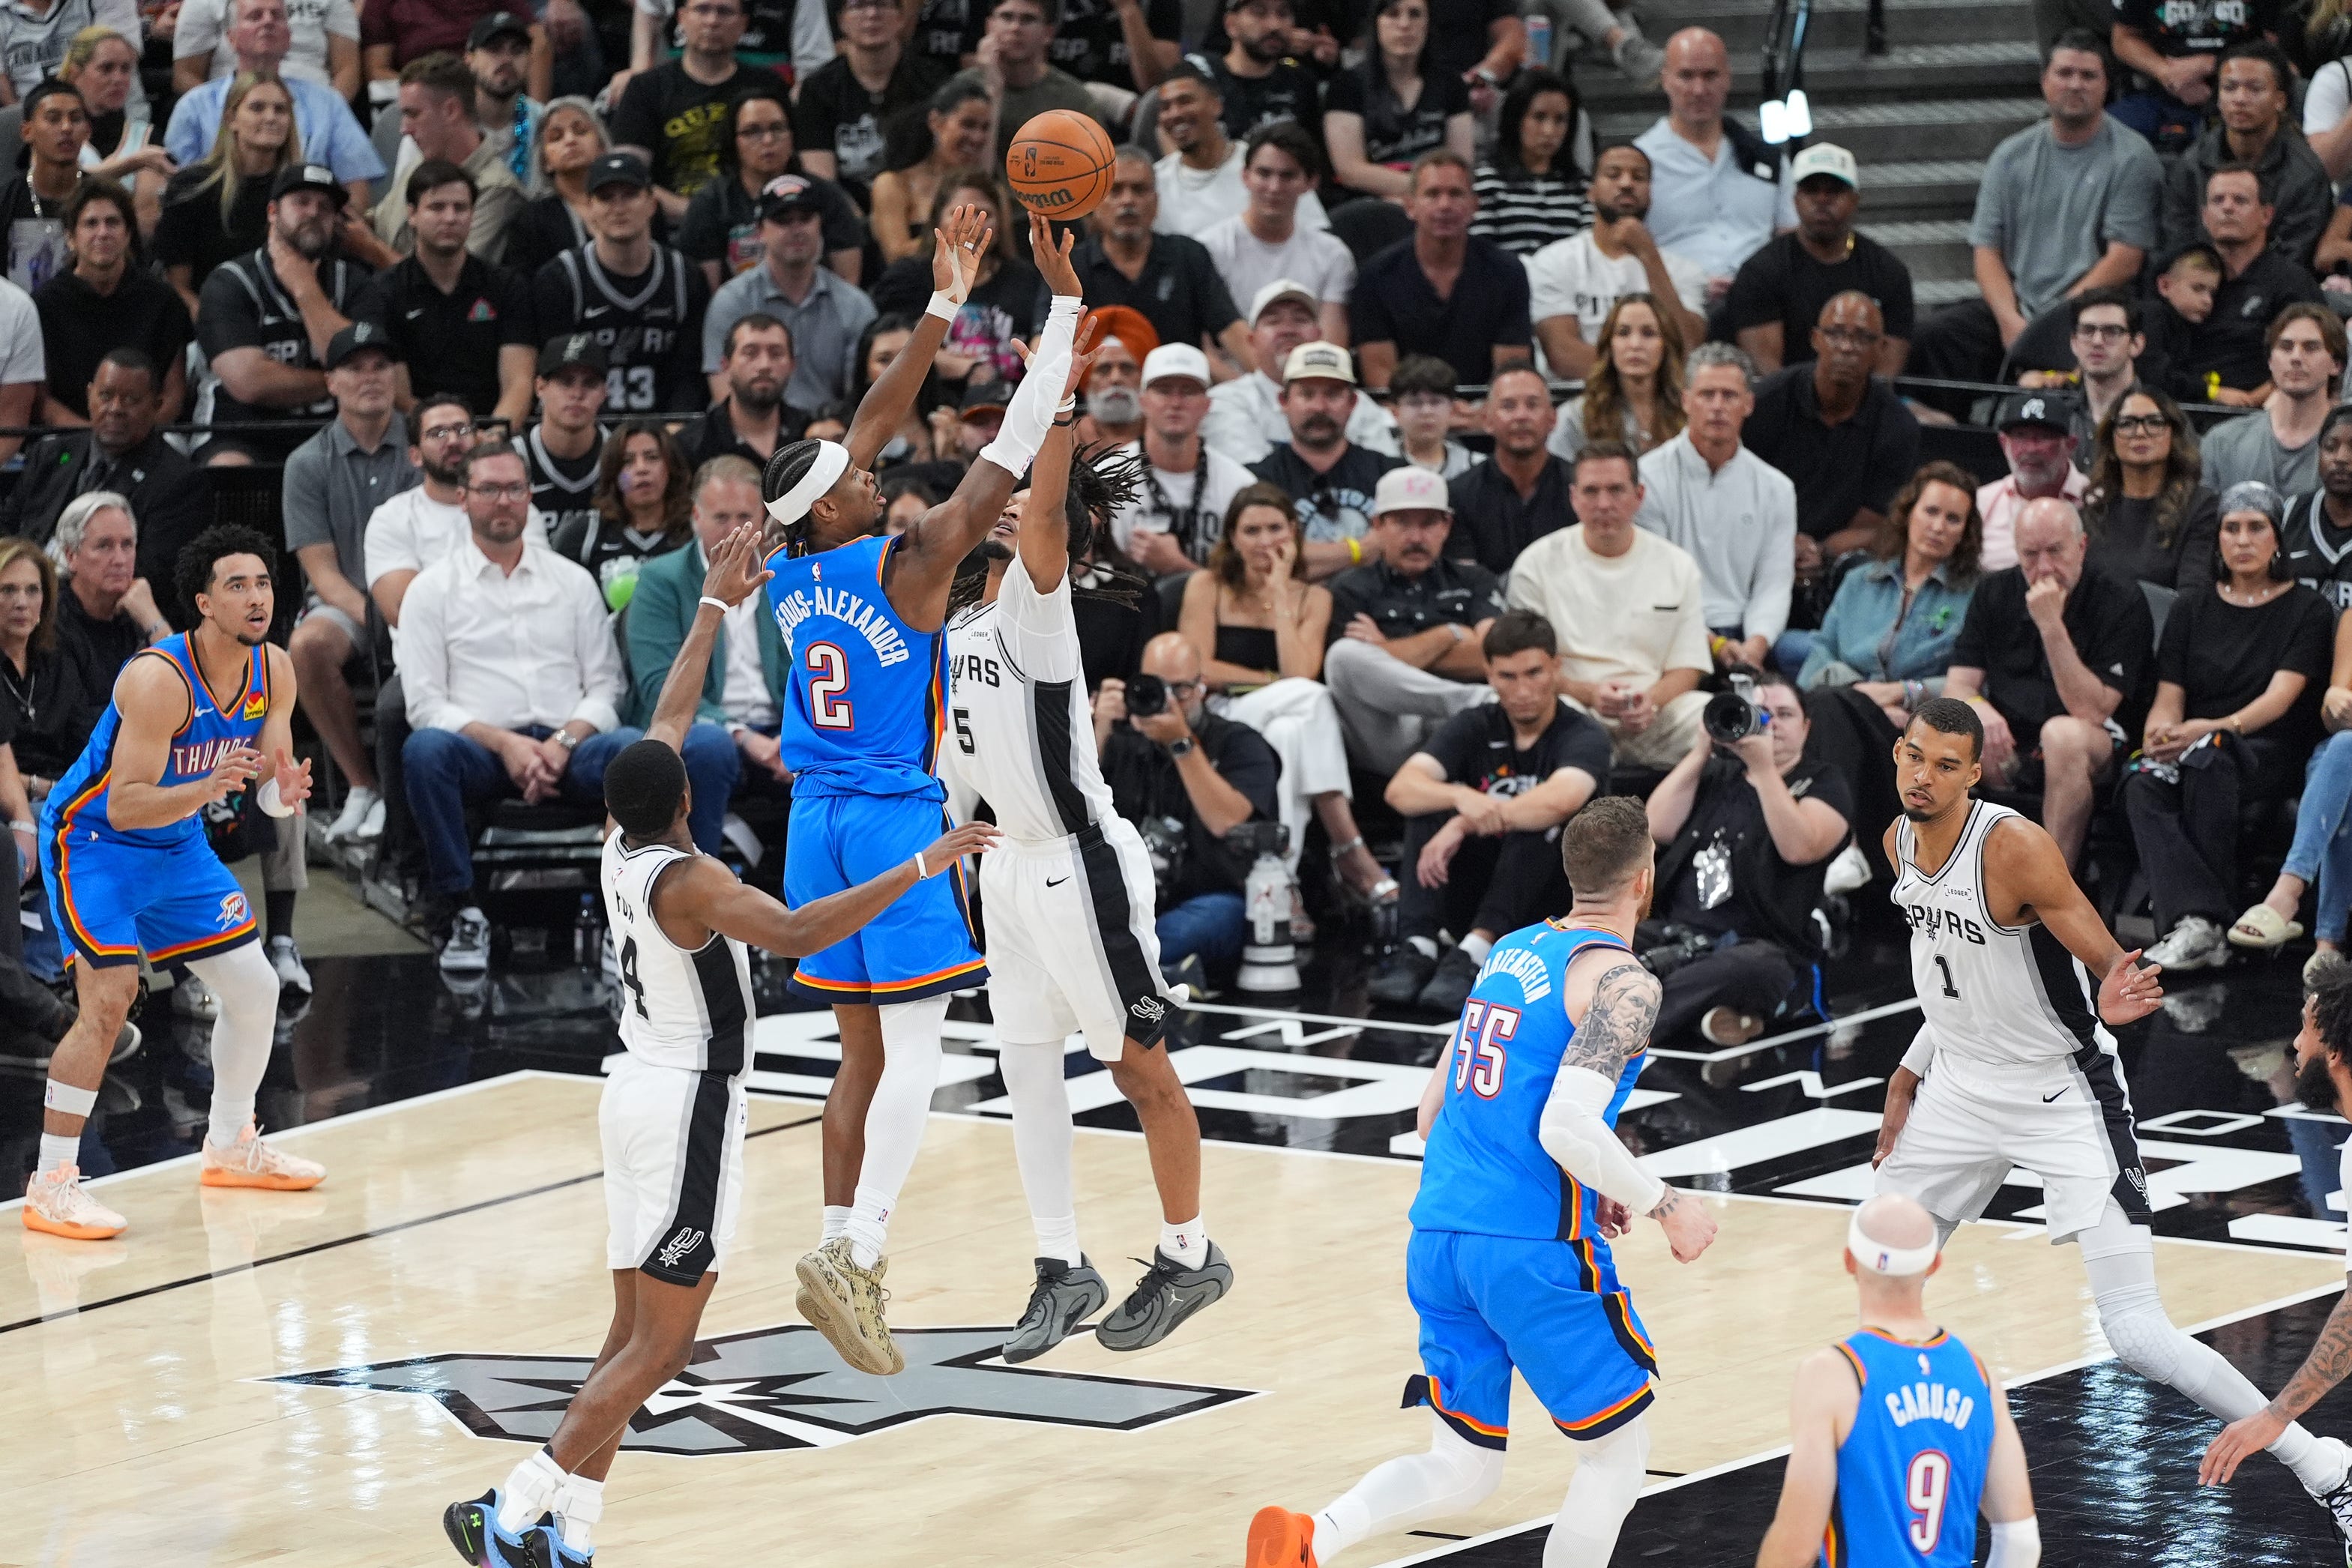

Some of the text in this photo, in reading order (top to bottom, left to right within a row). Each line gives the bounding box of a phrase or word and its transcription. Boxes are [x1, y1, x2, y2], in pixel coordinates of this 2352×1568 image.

[775, 585, 910, 668] EOUS-ALEXANDER
[971, 630, 989, 638] LEDGER
[805, 640, 854, 732] 2
[949, 654, 1000, 696] URS
[172, 736, 253, 777] THUND
[952, 706, 975, 757] 5
[1947, 887, 1969, 897] LEDGER
[619, 929, 651, 1026] 4
[1933, 953, 1961, 1001] 1
[1456, 997, 1522, 1101] 55
[1884, 1381, 1975, 1431] CARUSO
[1906, 1447, 1952, 1557] 9
